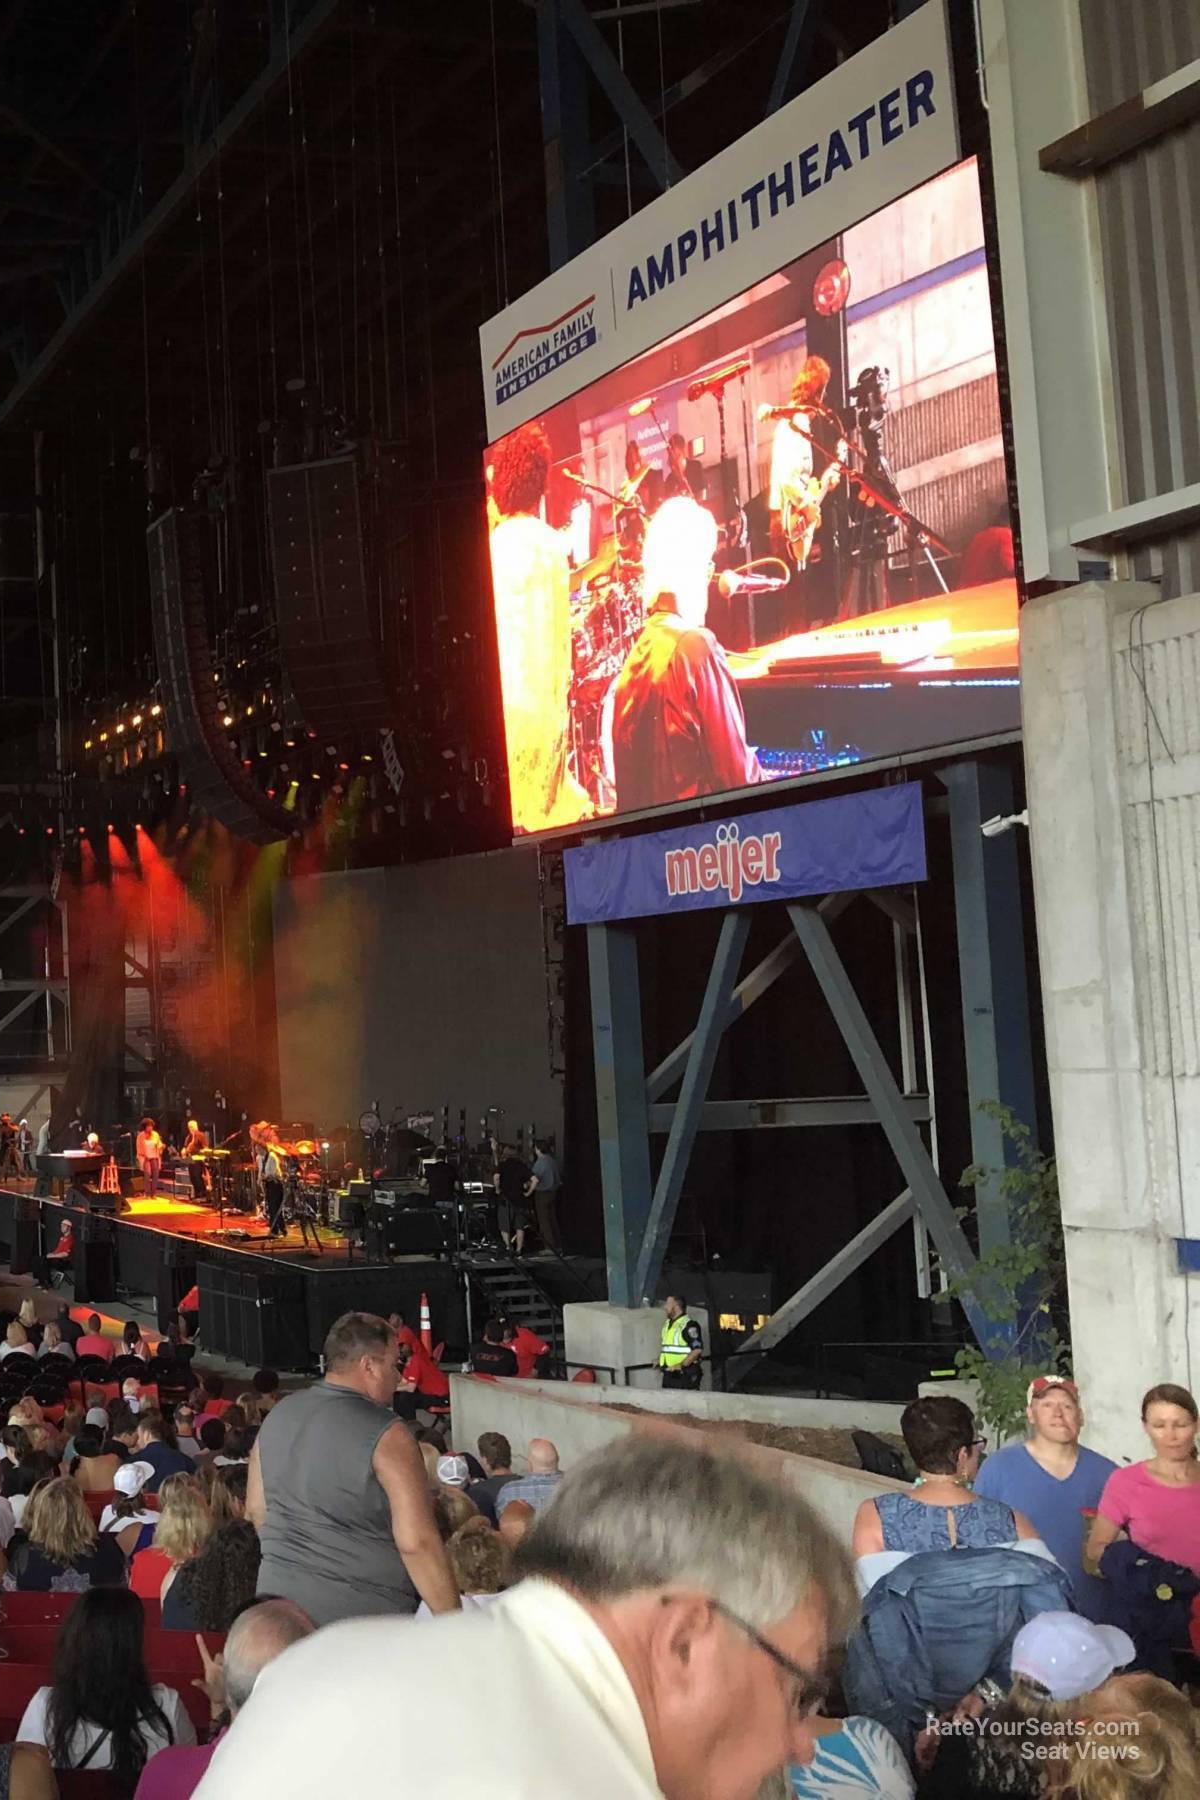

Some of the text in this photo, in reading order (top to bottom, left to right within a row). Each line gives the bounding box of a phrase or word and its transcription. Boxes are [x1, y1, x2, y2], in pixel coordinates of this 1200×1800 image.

[627, 69, 936, 311] AMPHITHEATER
[496, 308, 595, 387] AMERICAN FAMILY
[503, 334, 589, 399] INSURANCE
[665, 823, 781, 902] meijer
